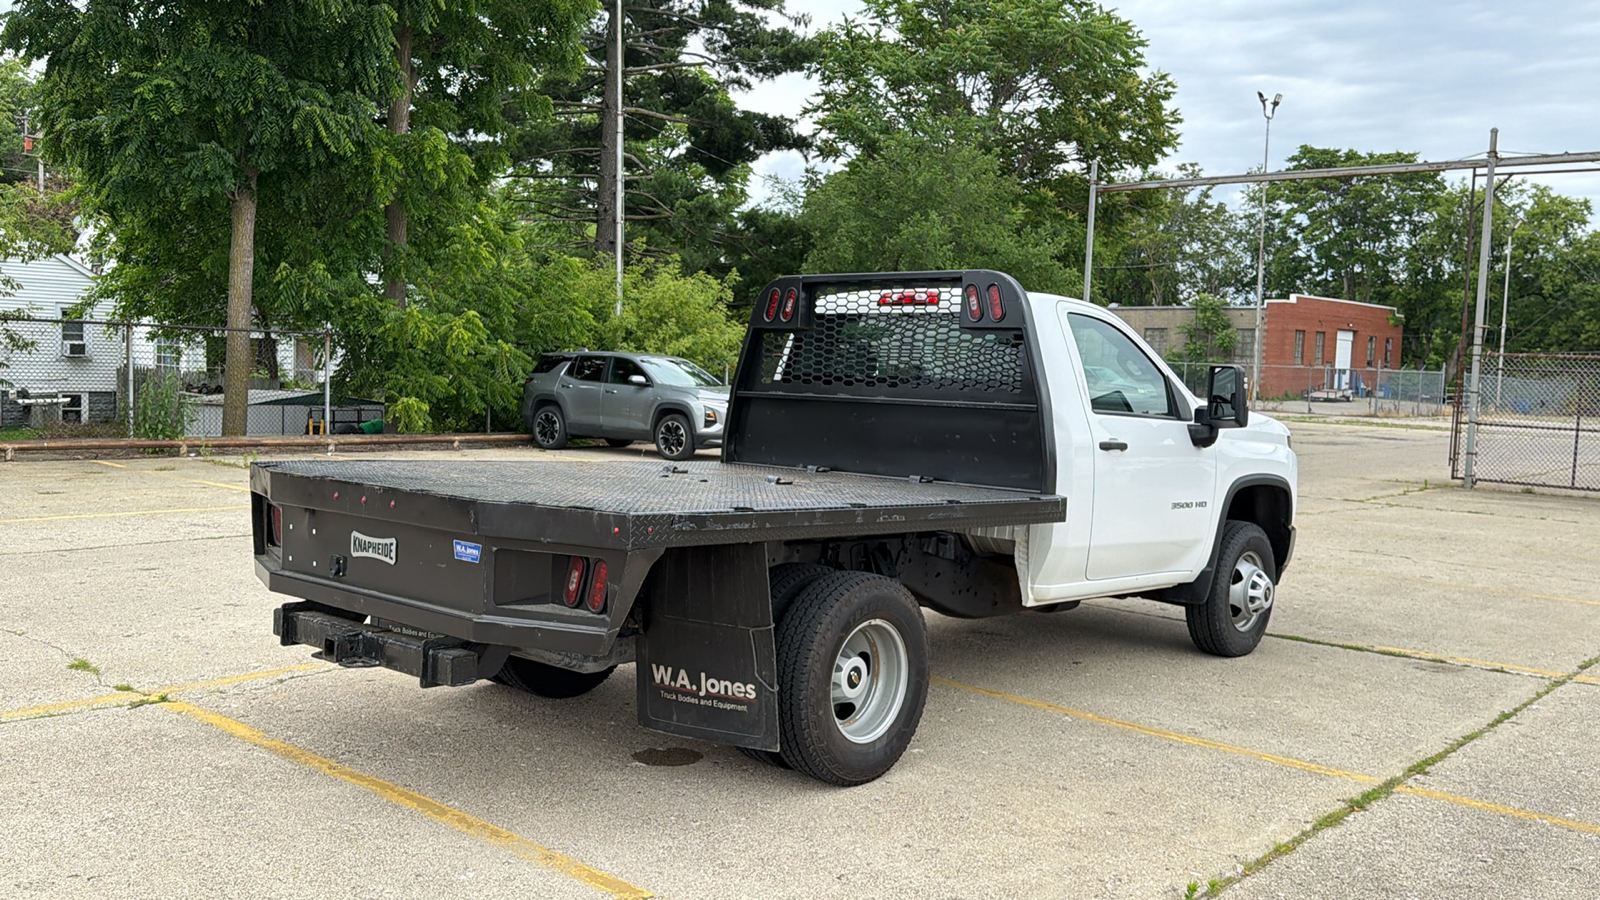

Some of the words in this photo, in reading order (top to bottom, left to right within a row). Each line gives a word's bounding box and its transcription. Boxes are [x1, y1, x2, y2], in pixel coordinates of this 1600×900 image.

[1171, 502, 1194, 510] 3500
[352, 535, 394, 560] KNAPHEIDE
[660, 690, 677, 700] Truck
[677, 693, 699, 705] Bodies
[700, 698, 712, 707] and
[713, 700, 748, 712] Equipment
